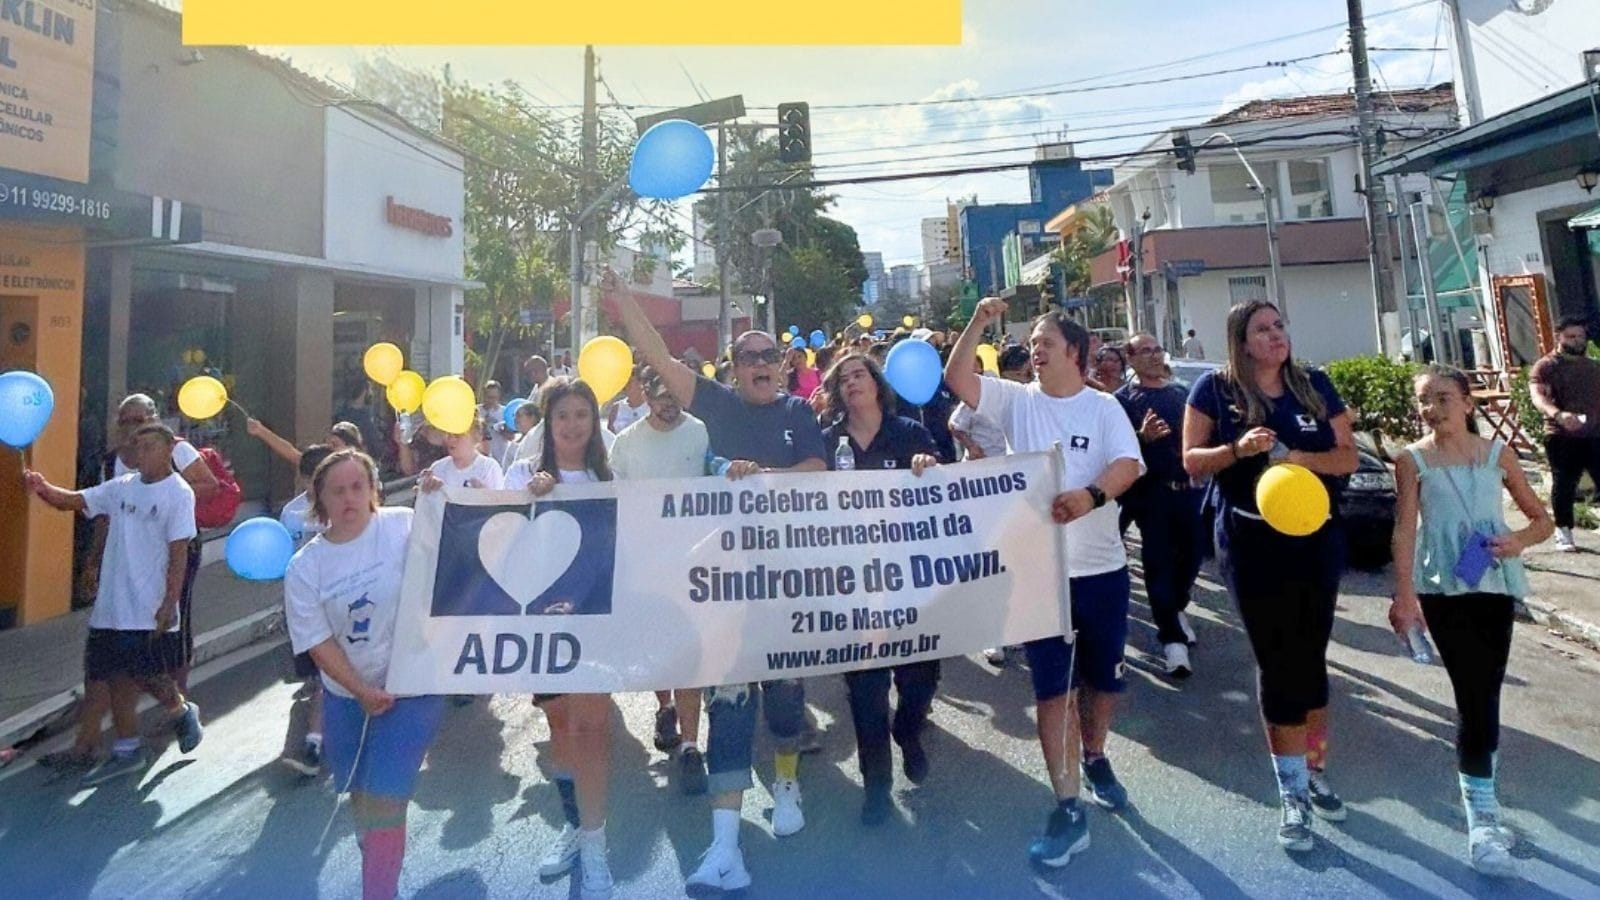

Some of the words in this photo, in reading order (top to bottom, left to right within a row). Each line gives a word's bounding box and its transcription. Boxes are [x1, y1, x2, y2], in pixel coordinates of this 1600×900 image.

[11, 186, 27, 206] 11
[32, 189, 111, 220] 99299-1816
[661, 494, 676, 518] A
[680, 489, 733, 517] ADID
[739, 488, 828, 515] Celebra
[838, 486, 885, 510] com
[889, 484, 943, 508] seus
[947, 471, 1027, 503] alunos
[721, 530, 735, 551] o
[741, 524, 779, 551] Dia
[786, 516, 938, 549] Internacional
[944, 514, 972, 536] da
[689, 563, 856, 603] Sindrome
[863, 557, 904, 593] de
[910, 548, 1006, 589] Down.
[791, 611, 815, 634] 21
[820, 611, 847, 632] De
[852, 606, 918, 631] Março
[453, 632, 582, 675] ADID
[767, 632, 941, 670] www.adid.org.br
